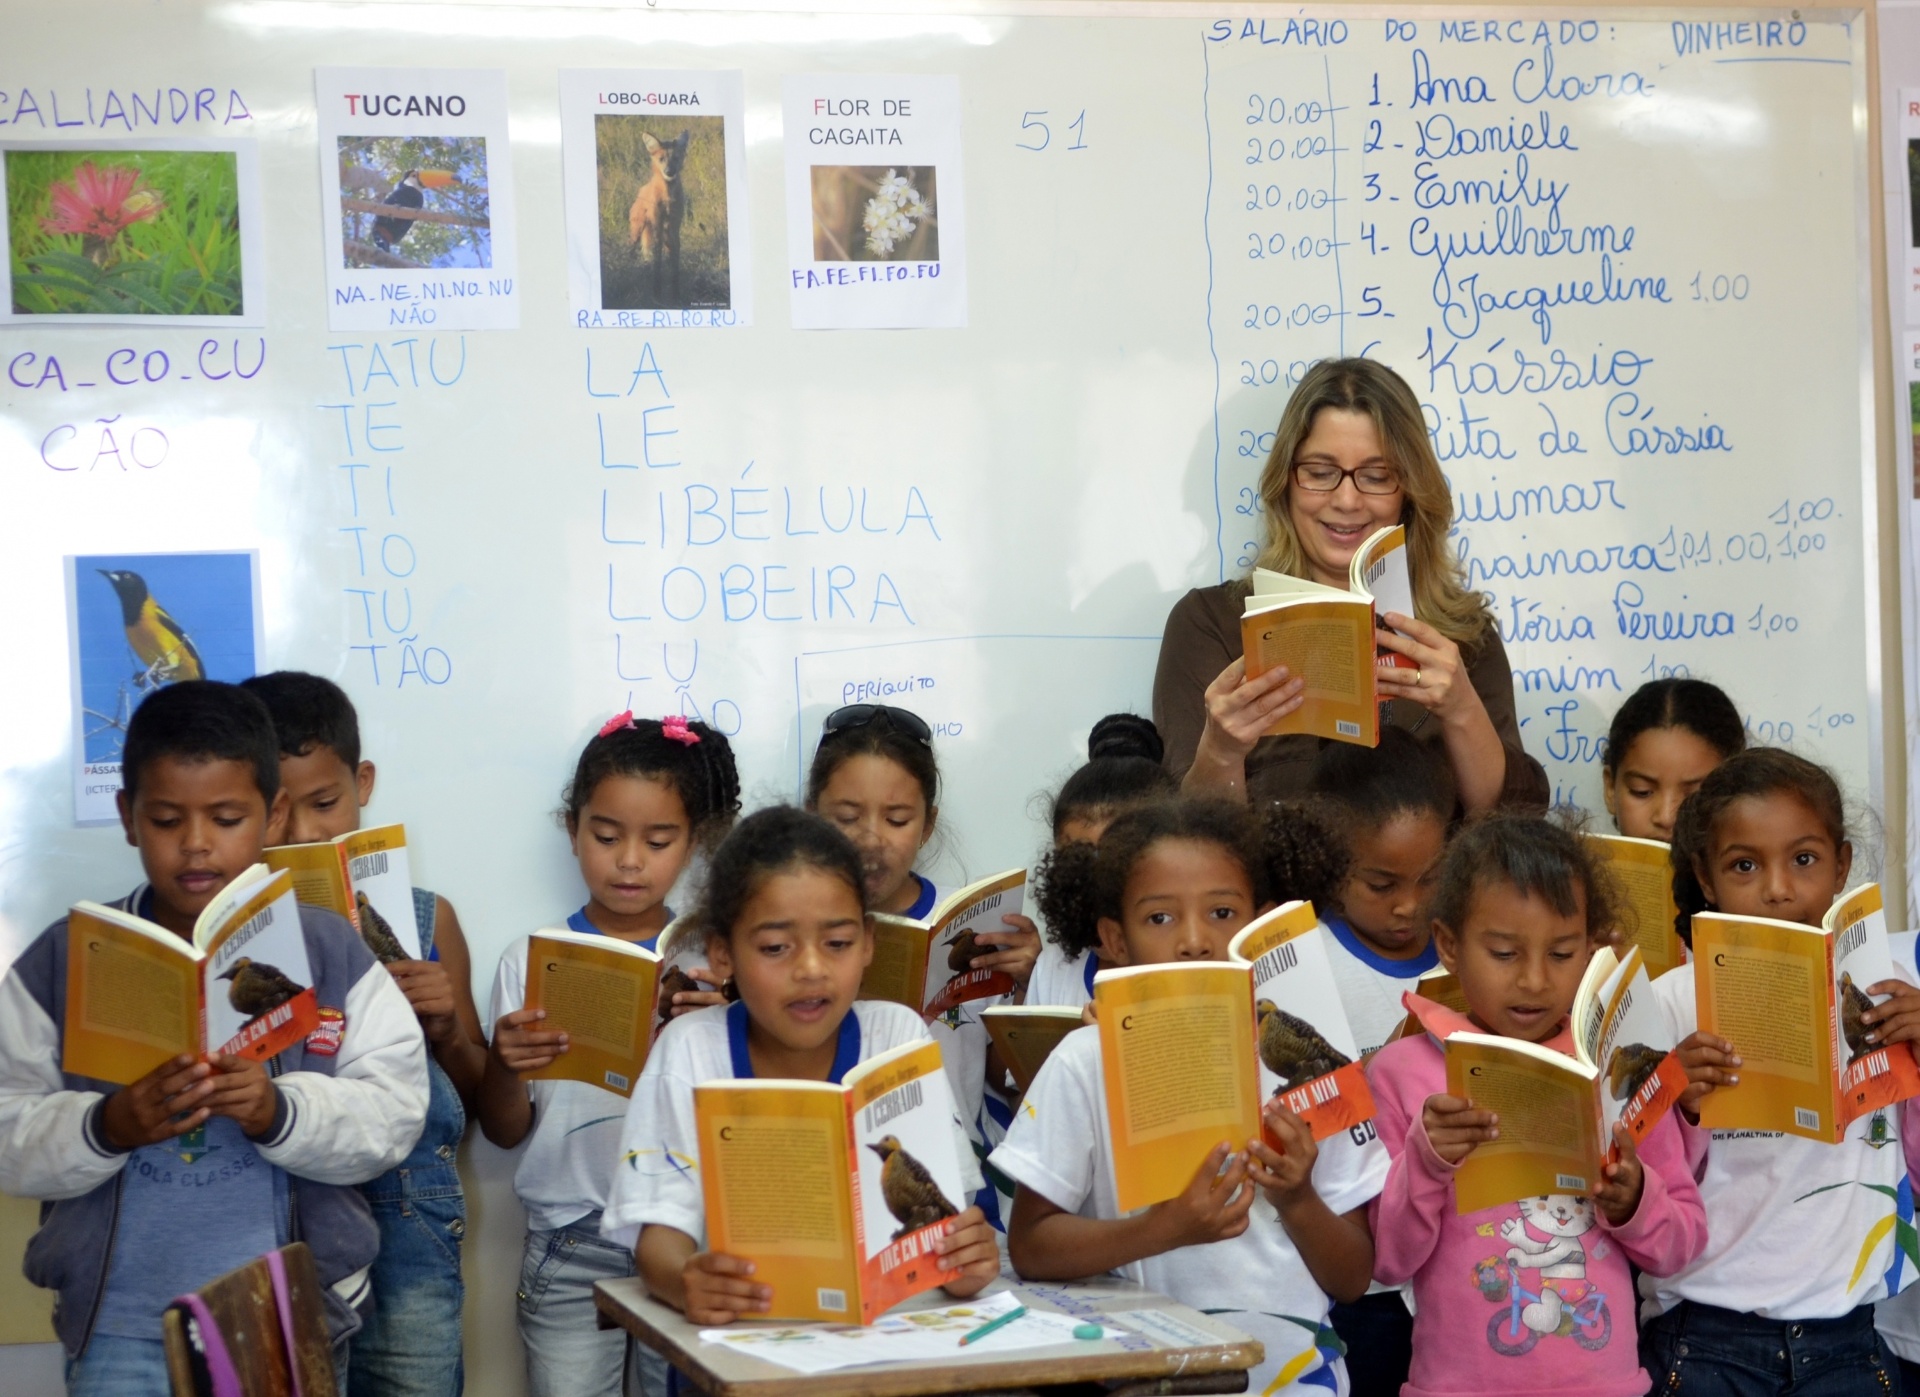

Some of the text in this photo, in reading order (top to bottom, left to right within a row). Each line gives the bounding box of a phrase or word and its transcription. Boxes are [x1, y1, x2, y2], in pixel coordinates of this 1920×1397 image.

[1207, 9, 1349, 47] SALÁRIO
[1385, 18, 1418, 43] DO
[1672, 20, 1807, 57] DINHEIRO
[598, 92, 701, 107] LOBO-GUARÁ
[1409, 48, 1498, 109] Ana
[0, 87, 253, 131] ALIANDRA
[344, 95, 467, 117] TUCANO
[814, 99, 912, 117] FLOR DE
[809, 127, 903, 145] CAGAITA
[1415, 110, 1580, 160] Daniele
[1414, 152, 1570, 235] Emily
[1409, 204, 1636, 308] Guilherme
[389, 301, 437, 326] NÃO
[1442, 252, 1673, 346] Jacqueline
[327, 335, 466, 398] TATU
[587, 342, 670, 398] LA
[1416, 328, 1655, 395] Kássio
[40, 413, 170, 472] CÃO
[316, 402, 404, 457] TE
[597, 405, 681, 469] LE
[1538, 402, 1588, 456] de
[1605, 392, 1734, 455] Cássia
[338, 464, 397, 517] TI
[601, 460, 942, 549] LIBÉLULA
[1450, 475, 1626, 525] uimar
[338, 526, 417, 578] TO
[1456, 533, 1677, 592] hainara
[342, 588, 412, 639] TU
[608, 562, 916, 625] LOBEIRA
[1484, 591, 1596, 644] itória
[1612, 580, 1736, 641] Pereira
[350, 634, 453, 689] TÃO
[615, 632, 699, 683] LU
[1511, 654, 1623, 694] mim
[970, 968, 992, 984] MIM
[1254, 942, 1299, 990] RRADO
[1640, 1072, 1662, 1104] MIM
[1852, 1060, 1867, 1086] EM
[1866, 1050, 1891, 1078] MIM
[873, 1079, 923, 1128] CERRADO
[1288, 1074, 1340, 1114] EM MIM
[1726, 1130, 1773, 1140] PLANALTINA
[901, 1234, 919, 1263] EM
